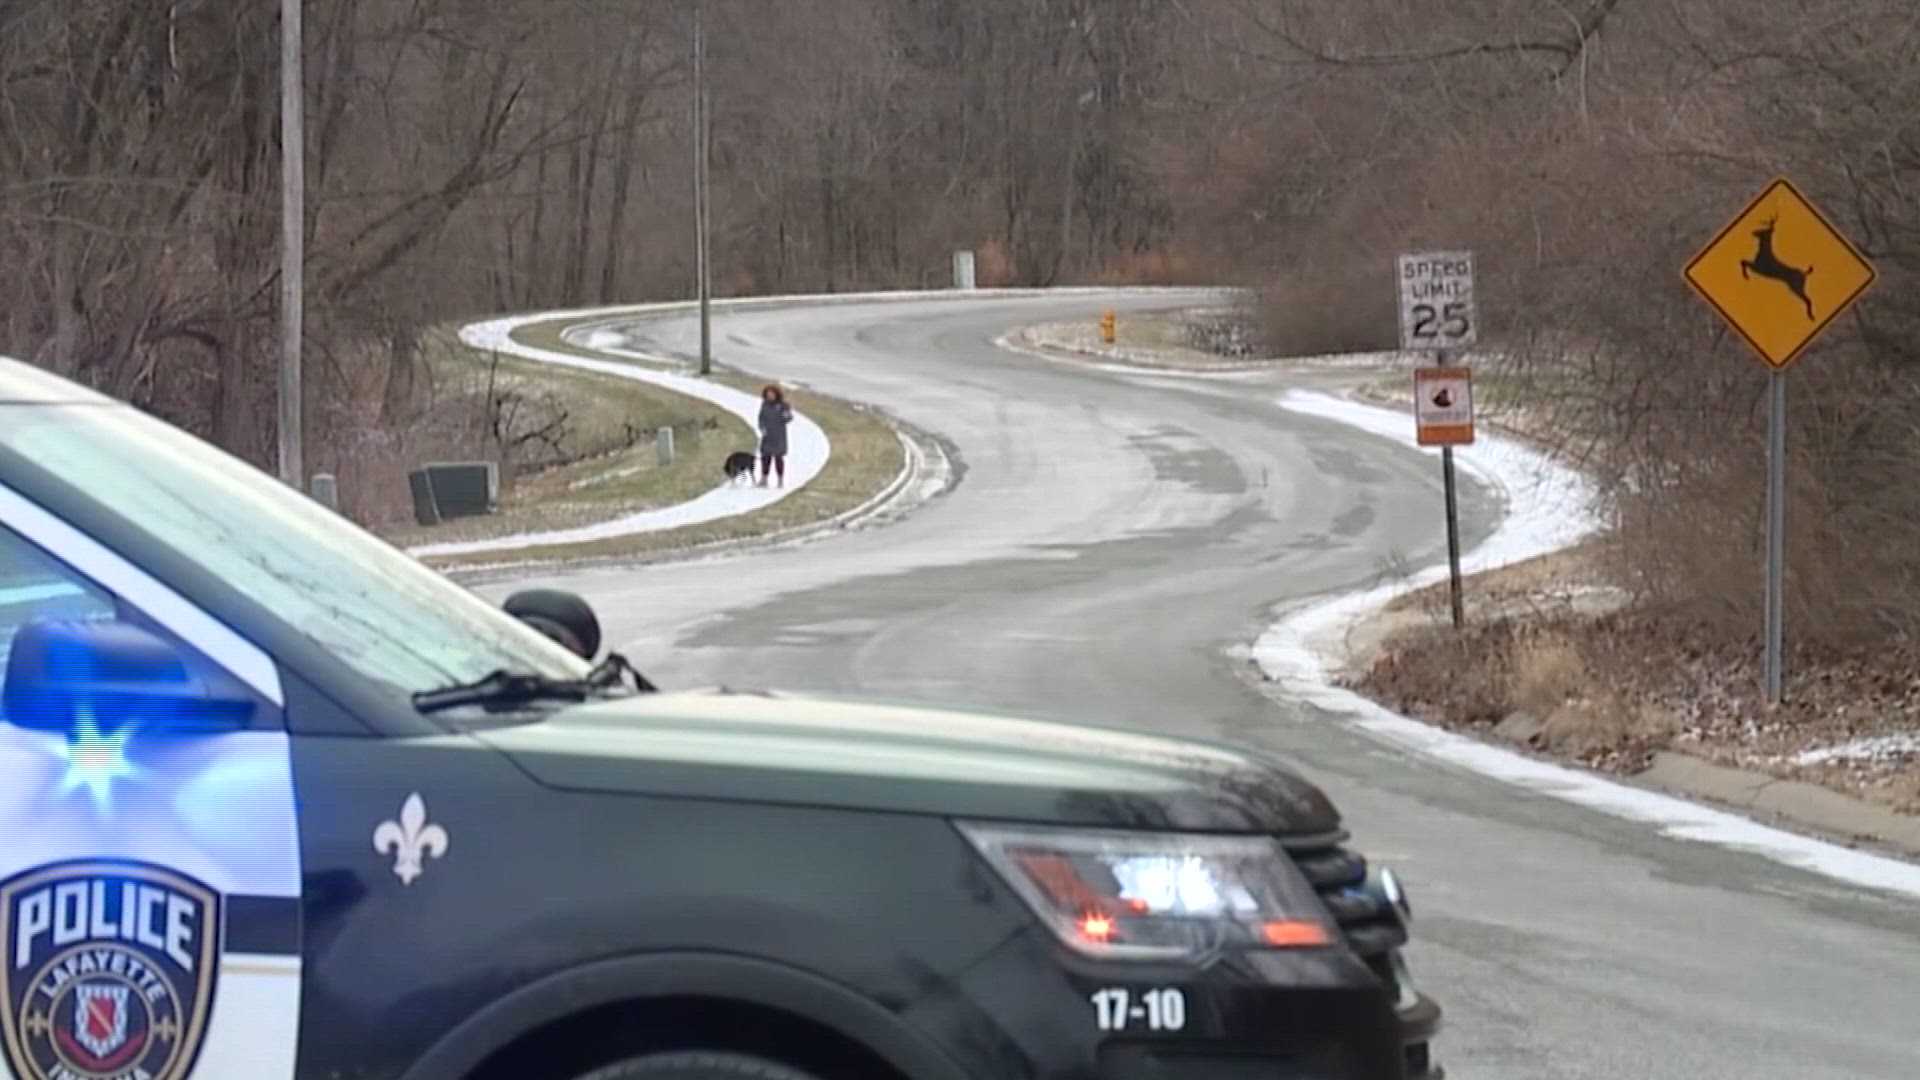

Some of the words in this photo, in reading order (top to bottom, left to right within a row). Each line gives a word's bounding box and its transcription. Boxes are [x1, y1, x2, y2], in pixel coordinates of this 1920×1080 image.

[1404, 261, 1468, 279] SPEED
[1412, 283, 1460, 298] LIMIT
[1412, 303, 1469, 338] 25
[16, 880, 194, 972] POLICE
[40, 951, 166, 1003] LAFAYETTE
[1091, 988, 1185, 1030] 17-10
